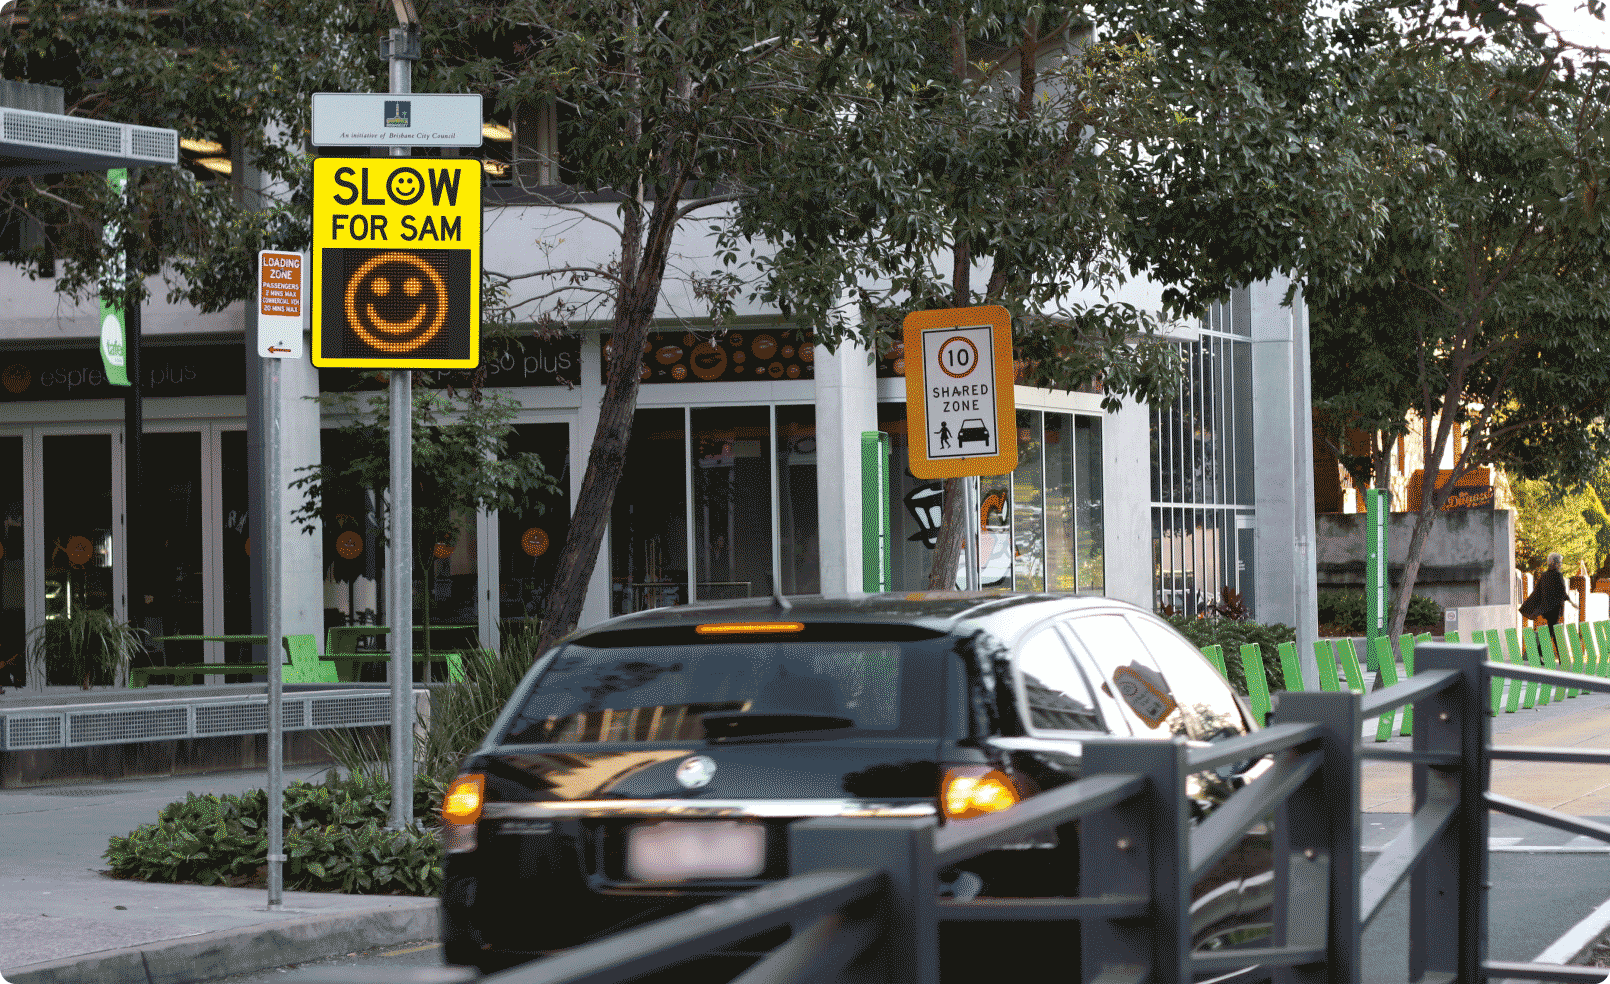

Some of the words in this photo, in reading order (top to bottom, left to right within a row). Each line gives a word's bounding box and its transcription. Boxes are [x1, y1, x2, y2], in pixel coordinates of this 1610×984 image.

[379, 132, 386, 140] of
[416, 132, 430, 140] City
[333, 166, 462, 206] SLOW
[332, 214, 388, 241] FOR
[400, 214, 462, 241] SAM
[262, 257, 300, 268] LOADING
[270, 268, 293, 279] ZONE
[262, 282, 299, 290] PASSENGERS
[265, 289, 270, 297] 2
[524, 348, 571, 378] plus
[947, 348, 969, 367] 10
[932, 384, 989, 399] SHARED
[943, 399, 980, 413] ZONE
